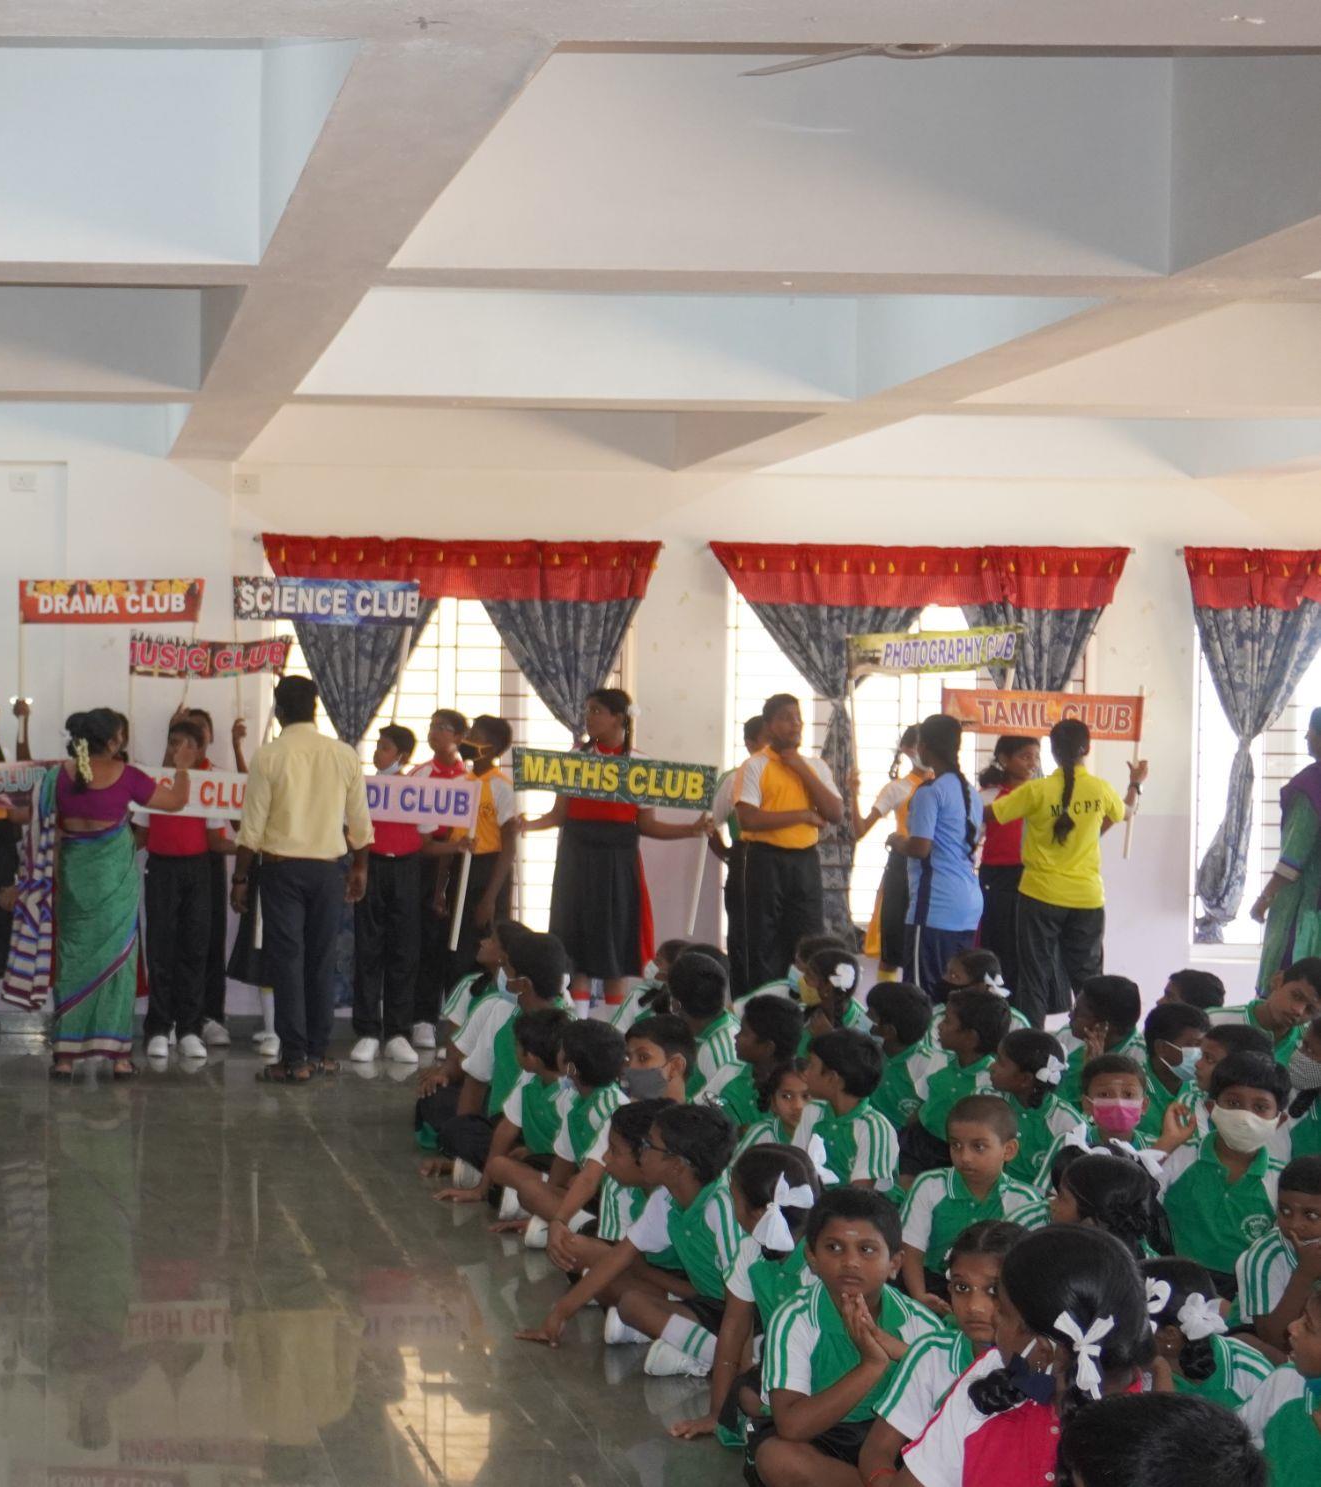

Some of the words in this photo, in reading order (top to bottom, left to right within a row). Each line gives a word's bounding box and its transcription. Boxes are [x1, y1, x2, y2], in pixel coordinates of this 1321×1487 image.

[38, 593, 120, 615] DRAMA
[125, 593, 186, 614] CLUB
[240, 584, 348, 616] SCIENCE
[355, 588, 420, 619] CLUB
[214, 642, 287, 672] CLUB
[882, 637, 983, 668] PHOTOGRAPHY
[977, 699, 1055, 730] TAMIL
[521, 754, 620, 793] MATHS
[627, 765, 706, 802] CLUB
[199, 780, 247, 810] CLU
[399, 787, 471, 817] CLUB
